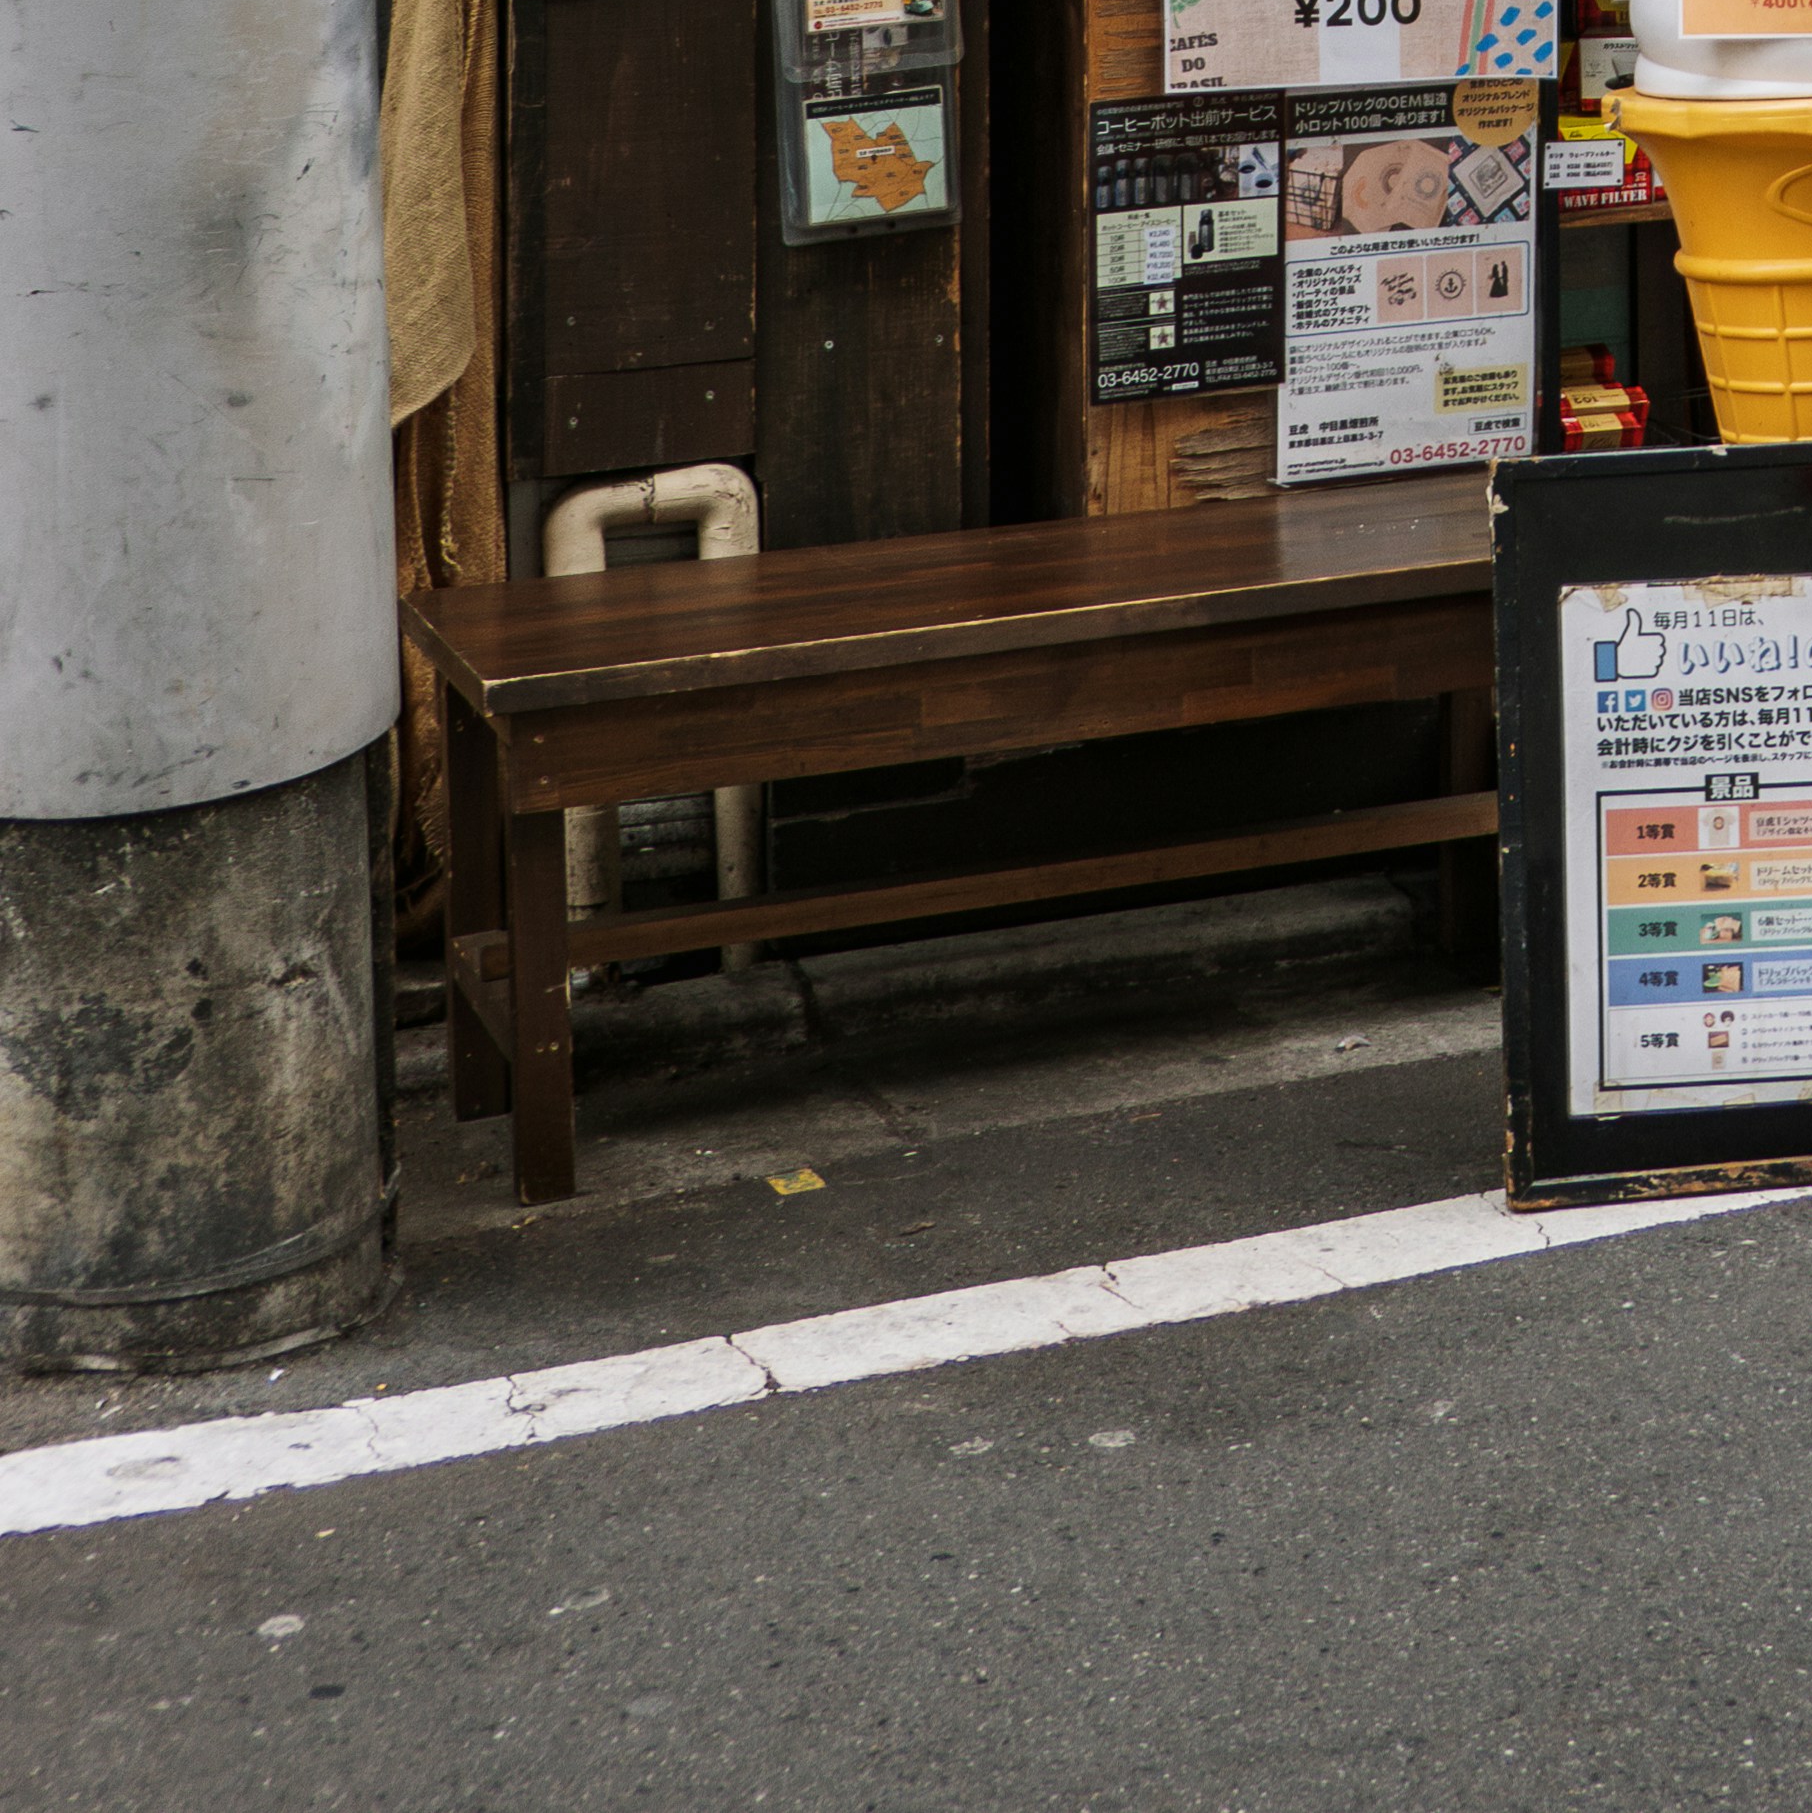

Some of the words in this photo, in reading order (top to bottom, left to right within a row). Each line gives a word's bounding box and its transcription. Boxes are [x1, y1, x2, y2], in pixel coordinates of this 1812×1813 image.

[1181, 57, 1206, 74] DO
[1563, 190, 1599, 209] WAVE
[1599, 188, 1648, 206] FILTER
[1097, 361, 1200, 390] 03-6452-2770
[1389, 435, 1527, 466] 03-6452-2770
[1709, 775, 1755, 799] 景品
[1635, 823, 1676, 841] 1等賞
[1637, 872, 1678, 889] 2等賞
[1638, 921, 1679, 938] 3等賞
[1638, 970, 1679, 987] 4等賞
[1640, 1032, 1680, 1049] 5等賞
